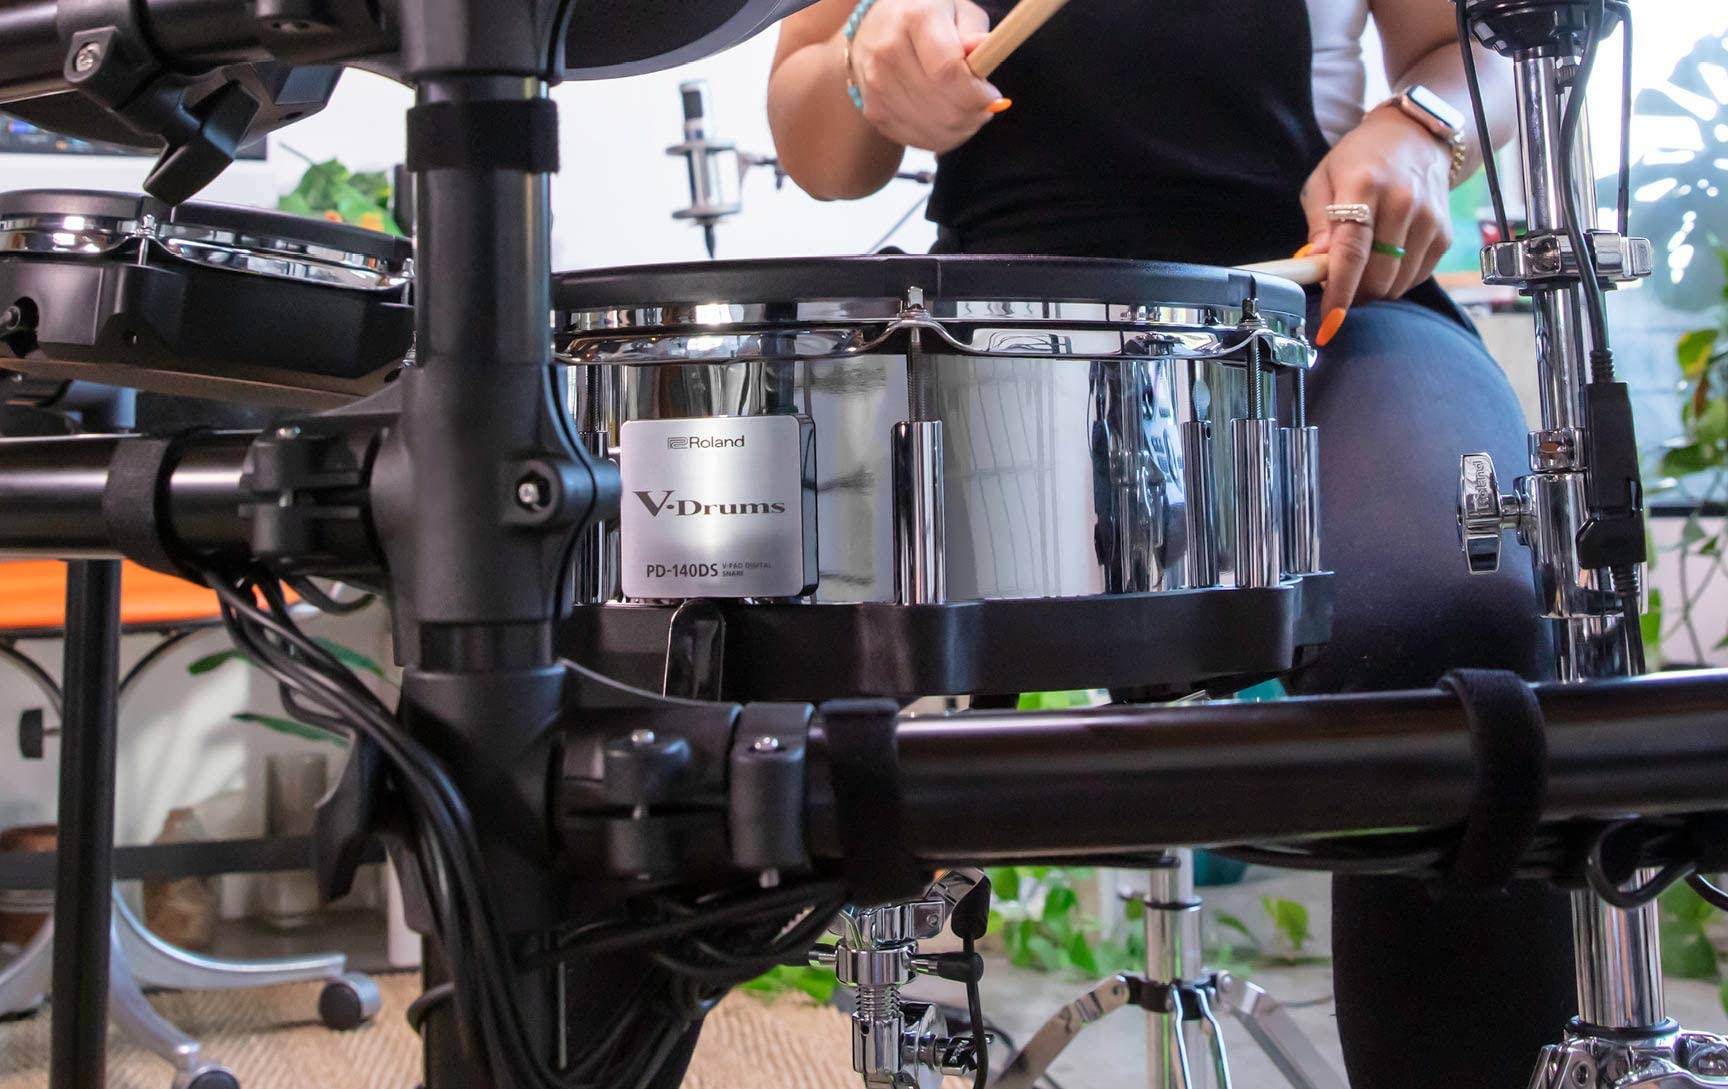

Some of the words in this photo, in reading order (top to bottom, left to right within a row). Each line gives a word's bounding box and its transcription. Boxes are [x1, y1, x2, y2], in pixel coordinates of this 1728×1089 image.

[689, 435, 745, 448] Roland
[1472, 460, 1490, 511] Roland
[646, 563, 719, 578] PD-140DS
